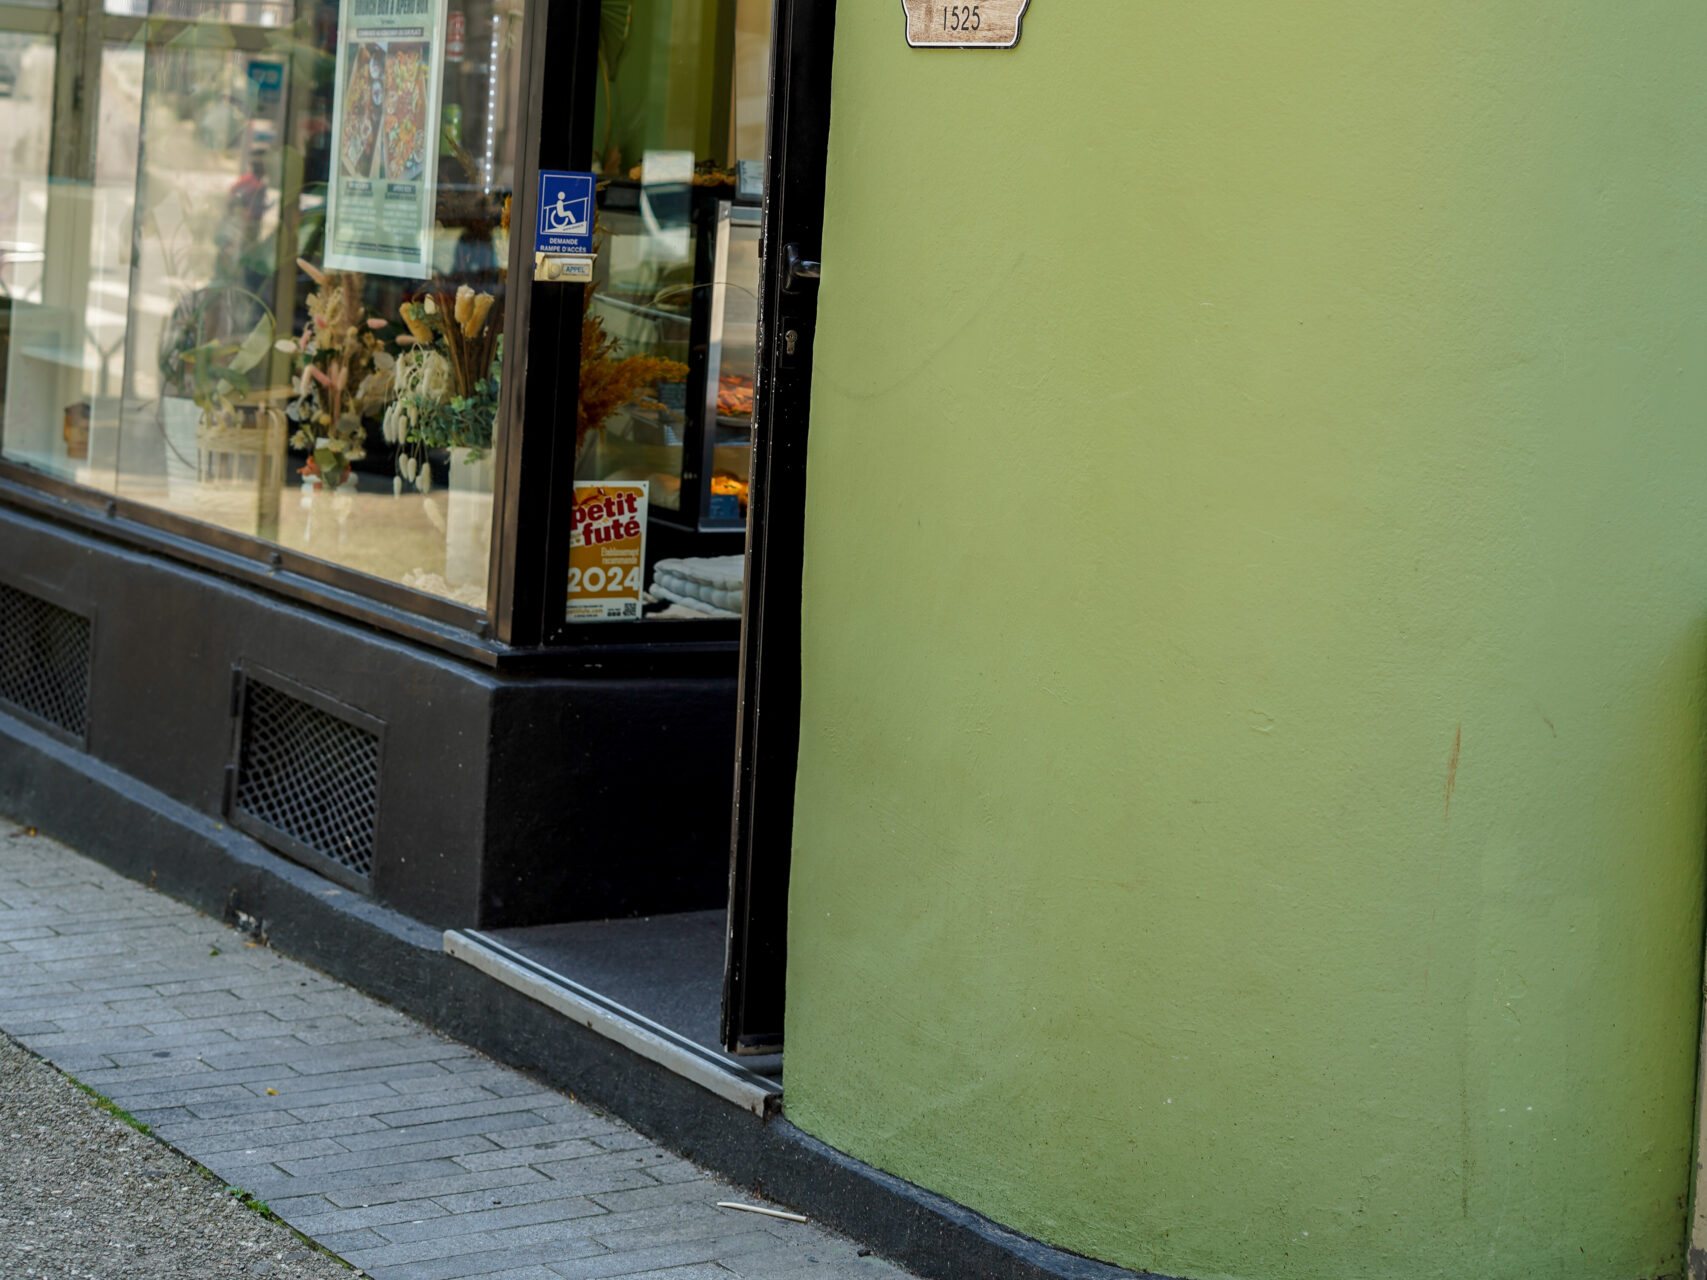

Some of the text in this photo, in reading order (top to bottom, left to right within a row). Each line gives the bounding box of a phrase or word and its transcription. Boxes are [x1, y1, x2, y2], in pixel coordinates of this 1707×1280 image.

[943, 5, 981, 31] 1525
[540, 244, 561, 252] RAMPE
[549, 237, 578, 245] DEMANDE
[566, 265, 585, 273] APPEL
[570, 492, 638, 530] petit
[582, 515, 641, 546] futé
[567, 566, 640, 593] 2024
